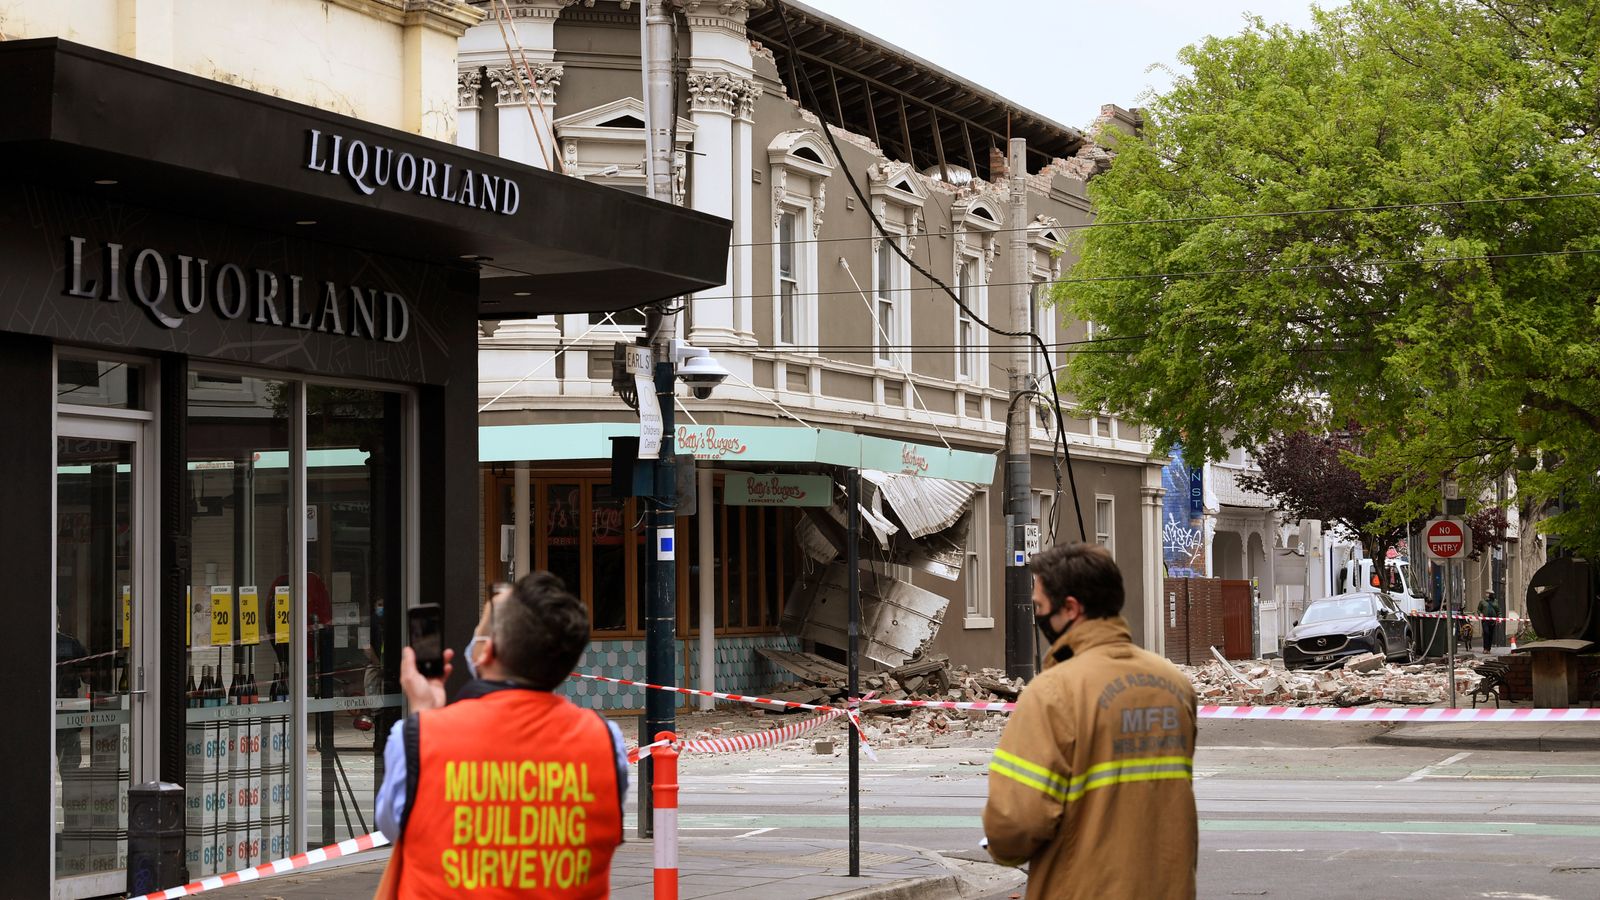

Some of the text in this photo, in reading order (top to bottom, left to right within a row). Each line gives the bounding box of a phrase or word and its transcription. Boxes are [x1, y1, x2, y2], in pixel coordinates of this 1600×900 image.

[307, 129, 521, 216] LIQUORLAND
[68, 236, 409, 343] LIQUORLAND
[627, 352, 651, 370] EARL S
[677, 426, 747, 455] Betty's Burgers
[1191, 467, 1202, 508] NST
[1026, 527, 1037, 537] ONE
[1439, 526, 1451, 535] NO
[1026, 540, 1038, 549] WAY
[1432, 544, 1458, 553] ENTRY
[213, 610, 229, 625] $20
[242, 611, 256, 625] $20
[66, 714, 116, 726] LIQUORLAND
[1121, 706, 1180, 734] MFB
[206, 739, 226, 758] 6F6
[445, 760, 595, 802] MUNICIPAL
[453, 805, 586, 845] BUILDING
[441, 848, 592, 890] SURVEYOR
